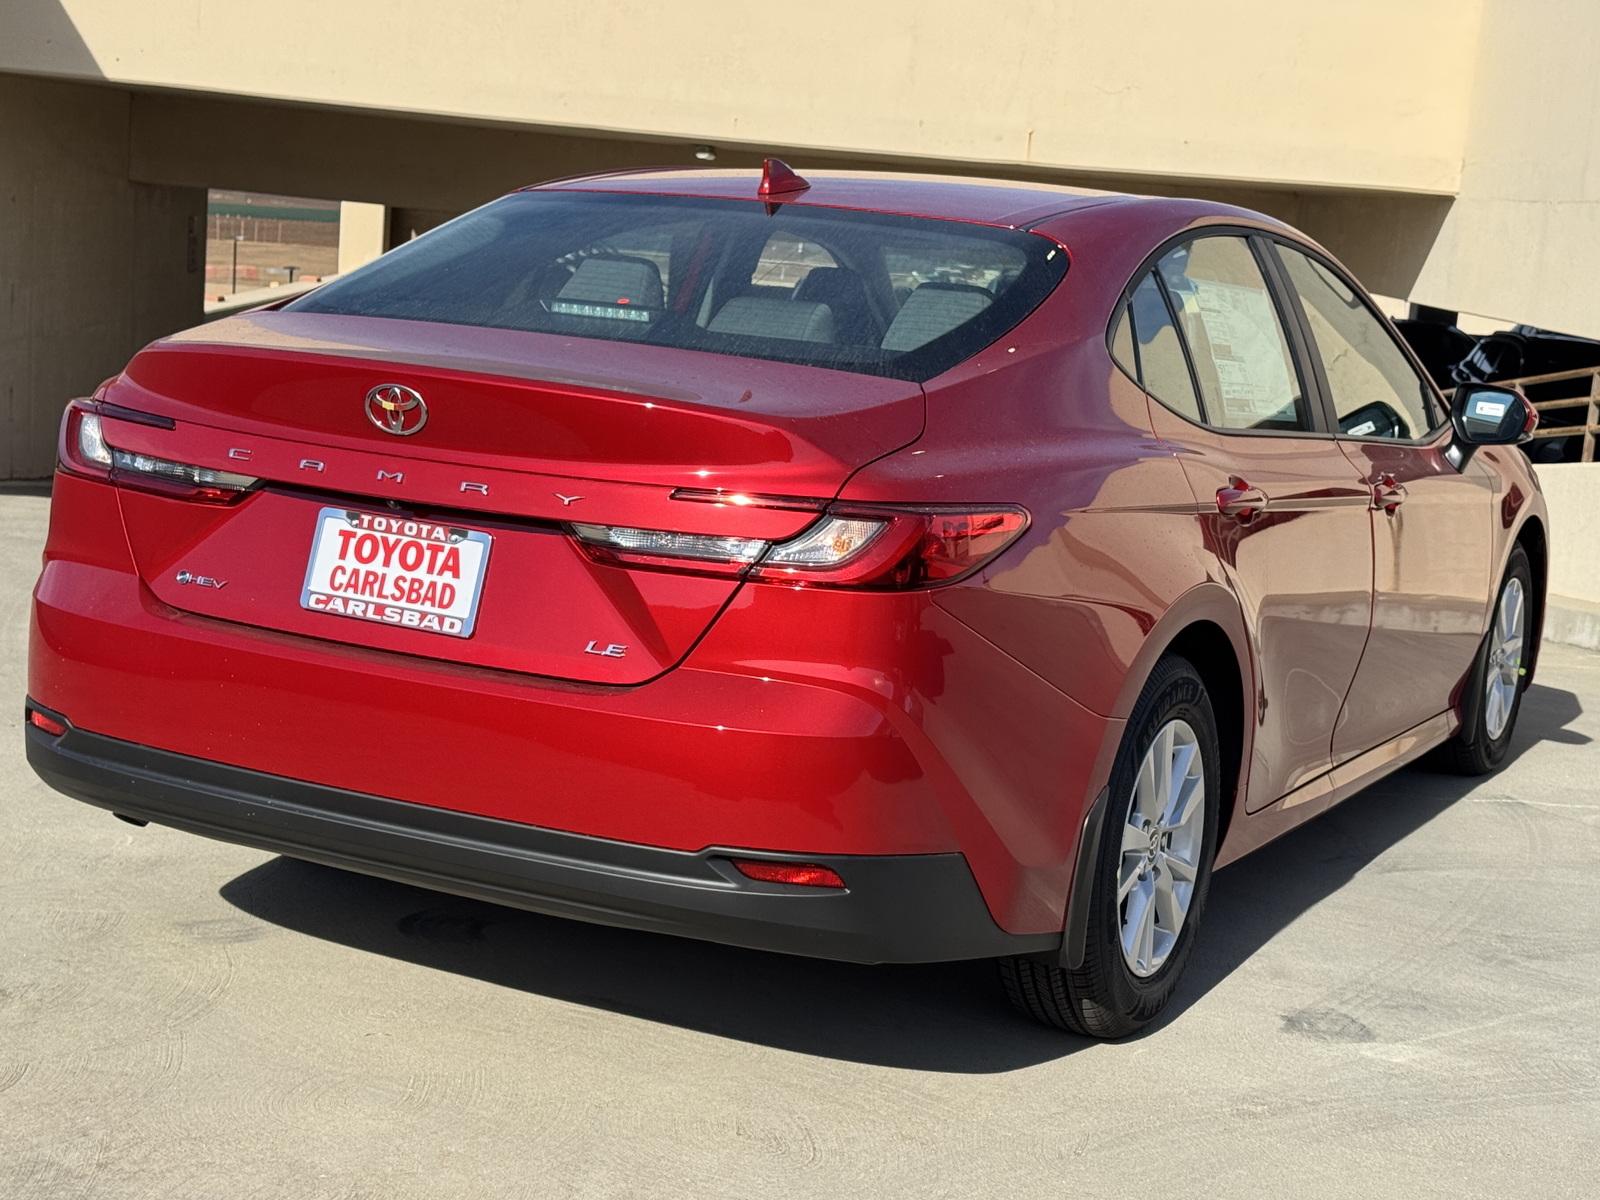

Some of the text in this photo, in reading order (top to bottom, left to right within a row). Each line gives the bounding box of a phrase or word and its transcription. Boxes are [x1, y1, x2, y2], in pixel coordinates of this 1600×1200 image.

[229, 447, 585, 506] CAMRY
[361, 514, 446, 541] TOYOTA
[338, 529, 461, 579] TOYOTA
[329, 565, 456, 610] CARLSBAD
[308, 593, 463, 634] CARLSBAD
[584, 640, 628, 659] LE
